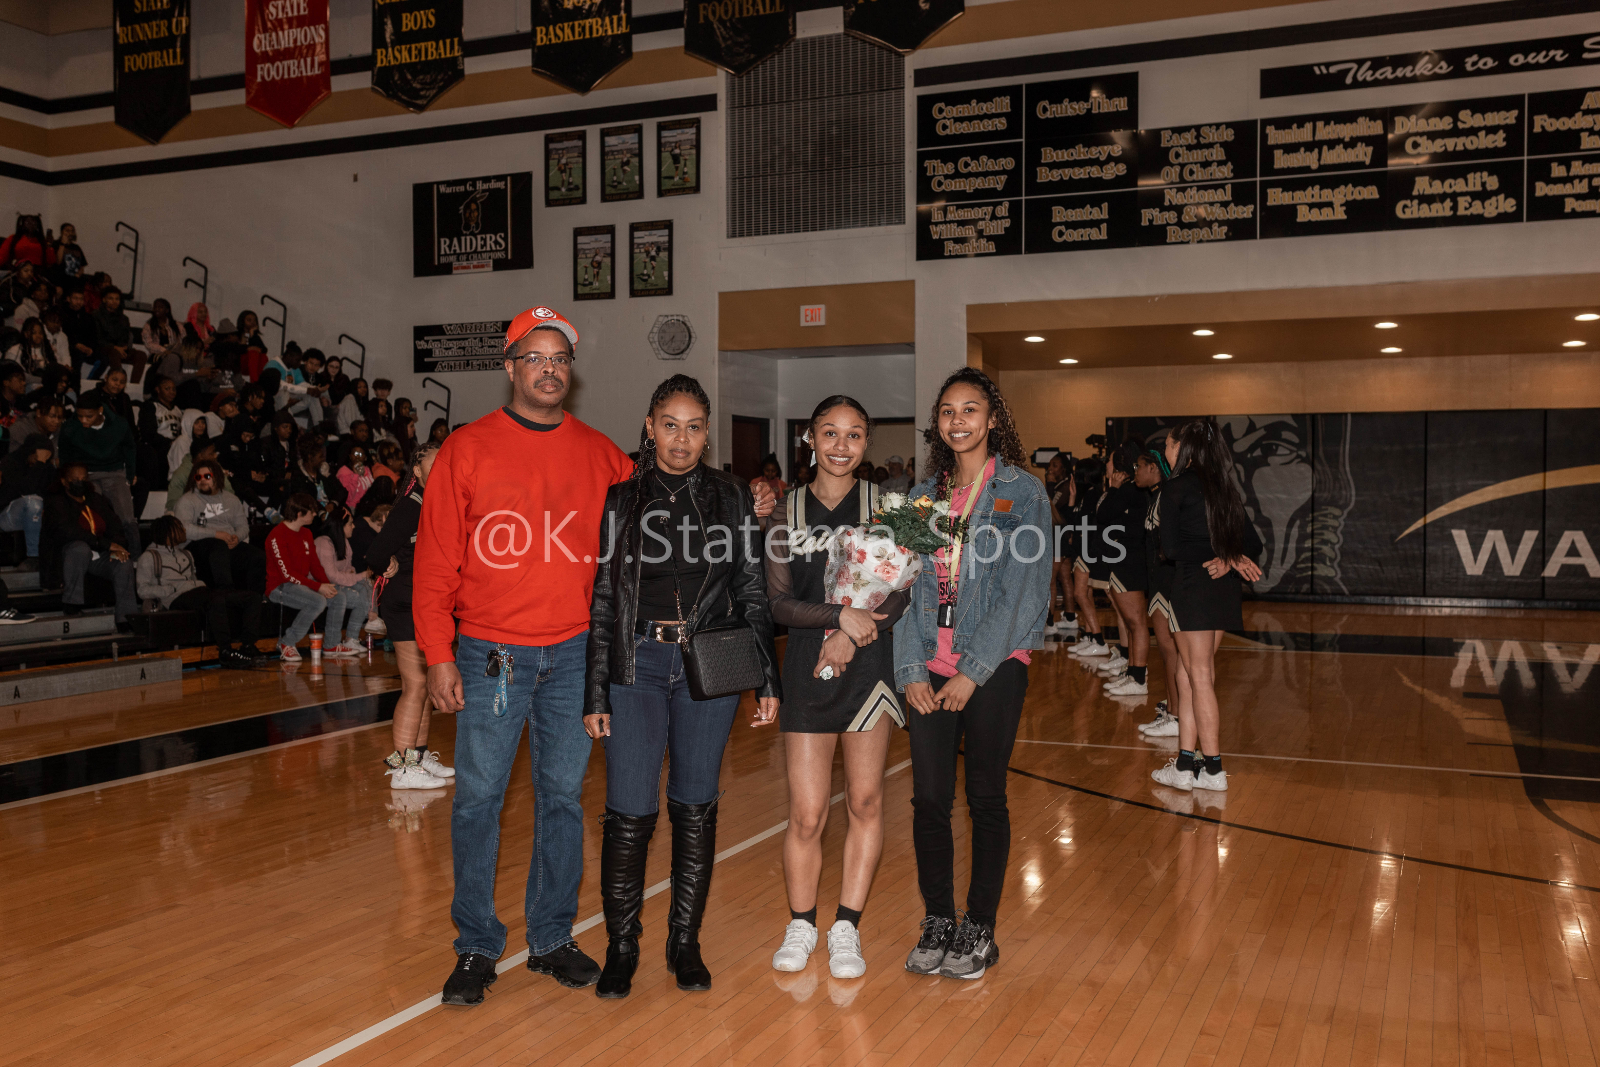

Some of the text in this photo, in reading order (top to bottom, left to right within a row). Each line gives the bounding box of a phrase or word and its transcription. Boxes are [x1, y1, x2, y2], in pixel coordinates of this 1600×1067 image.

[267, 0, 309, 20] STATE
[400, 9, 436, 32] BOYS
[698, 0, 785, 24] FOOTBALL
[118, 16, 189, 45] RUNNER UP
[252, 23, 326, 53] CHAMPIONS
[535, 13, 631, 47] BASKETBALL
[124, 48, 185, 73] FOOTBALL
[376, 37, 462, 68] BASKETBALL
[1464, 53, 1498, 71] to
[1508, 49, 1569, 67] our
[256, 56, 322, 82] FOOTBALL
[932, 95, 1011, 119] Cornicelli
[935, 116, 1008, 136] Cleaners
[1266, 116, 1384, 145] Trumbull Metropolitan
[1394, 108, 1519, 134] Diane Sauer
[1160, 123, 1235, 148] East Side
[1404, 129, 1507, 155] Chevrolet
[1041, 143, 1122, 163] Buckeye
[1168, 143, 1227, 164] Church
[1273, 142, 1374, 170] Housing Authority
[924, 155, 1015, 176] The Cafaro
[1036, 161, 1127, 182] Beverage
[1160, 161, 1234, 184] Of Christ
[1550, 161, 1568, 178] In
[439, 183, 466, 194] Warren
[475, 178, 506, 191] Harding
[931, 174, 1008, 193] Company
[1534, 178, 1590, 197] Donald
[1164, 183, 1233, 206] National
[1266, 183, 1380, 206] Huntington
[931, 201, 1010, 222] In Memory of
[1051, 202, 1109, 223] Rental
[1141, 202, 1255, 226] Fire & Water
[1296, 202, 1348, 223] Bank
[1395, 193, 1518, 219] Giant Eagle
[929, 223, 975, 240] William
[1051, 222, 1107, 242] Corral
[1166, 222, 1229, 244] Repair
[440, 233, 506, 255] RAIDERS
[944, 237, 996, 256] Franklin
[468, 251, 506, 262] CHAMPIONS
[804, 307, 823, 323] EXIT
[442, 321, 503, 335] WARREN
[63, 621, 70, 634] B
[140, 667, 147, 680] A
[13, 685, 21, 699] A
